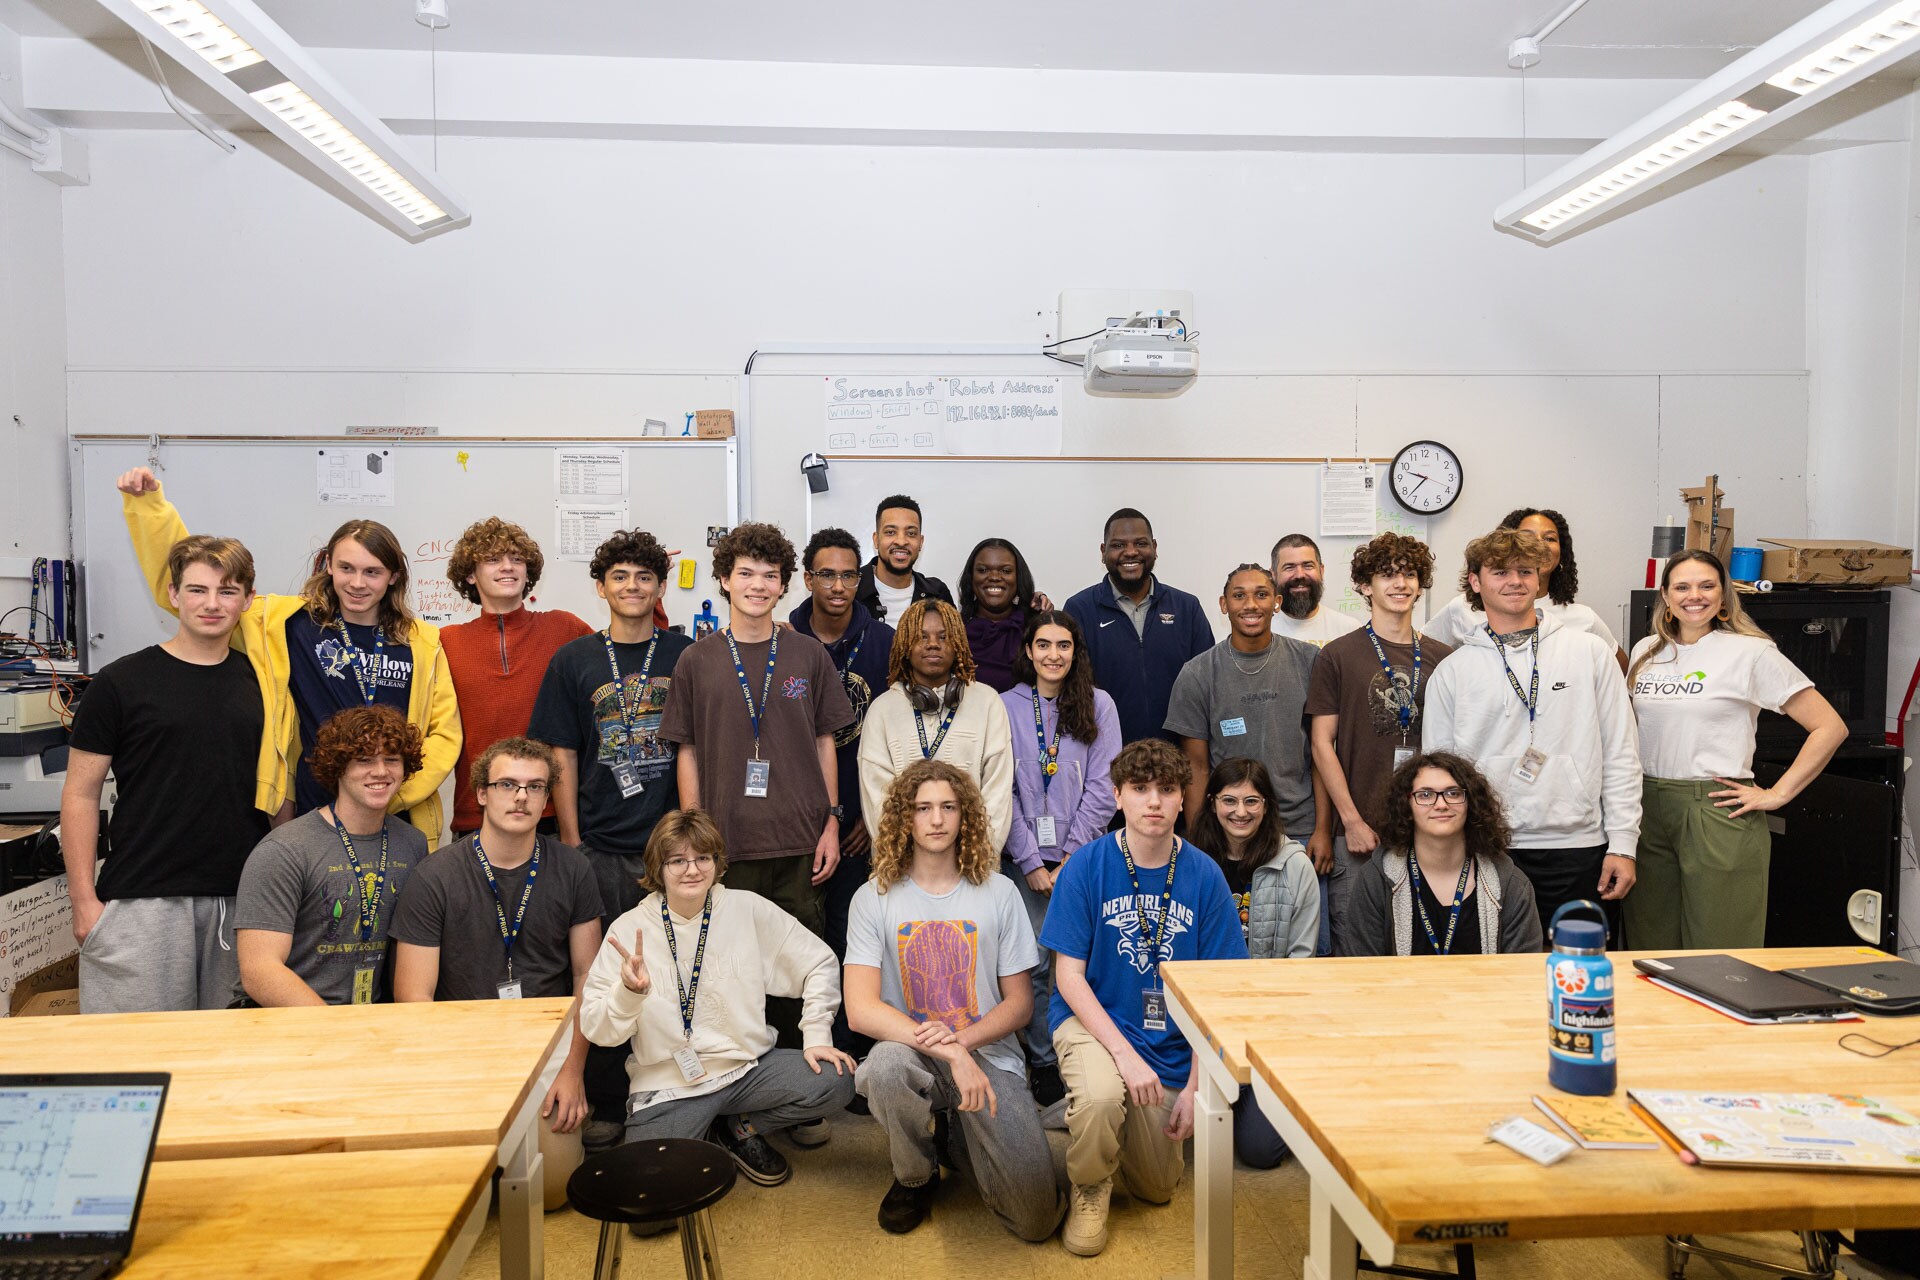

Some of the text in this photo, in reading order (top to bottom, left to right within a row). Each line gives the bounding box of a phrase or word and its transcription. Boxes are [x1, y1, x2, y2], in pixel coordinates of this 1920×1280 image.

[833, 378, 934, 400] Screenshot
[950, 378, 1054, 396] Robot Address
[1410, 453, 1416, 461] 11
[1421, 450, 1429, 458] 12
[1401, 463, 1410, 471] 10
[1444, 461, 1449, 469] 2
[1397, 474, 1403, 482] 9
[1448, 474, 1454, 482] 3
[1402, 487, 1408, 495] 8
[1436, 495, 1441, 503] 5
[1445, 486, 1450, 494] 4
[1412, 496, 1417, 504] 7
[1424, 498, 1429, 506] 6
[417, 540, 454, 556] CNC
[417, 591, 453, 600] Justice
[338, 618, 352, 647] LION PRIDE
[643, 659, 651, 672] LION
[647, 641, 656, 659] PRIDE
[727, 634, 740, 666] LION PRIDE
[1369, 632, 1386, 662] LION PRIDE
[354, 665, 362, 680] LION
[608, 648, 620, 680] LION PRIDE
[377, 680, 405, 688] RLEANS
[764, 672, 772, 691] PRIDE
[1508, 671, 1519, 689] PRIDE
[1639, 674, 1683, 682] COLLEGE
[1635, 682, 1703, 694] BEYOND
[631, 683, 644, 717] LION PRIDE
[742, 684, 755, 717] LION PRIDE
[916, 716, 926, 748] LION PRIDE
[935, 728, 946, 747] PRIDE
[348, 845, 357, 863] LION
[475, 845, 495, 882] LION PRIDE
[1121, 837, 1135, 875] LION PRIDE
[1166, 846, 1178, 885] LION PRIDE
[358, 877, 366, 899] PRIDE
[1457, 873, 1466, 893] PRIDE
[372, 887, 382, 906] LION
[516, 883, 532, 923] LION PRIDE
[1102, 894, 1194, 926] NEW ORLANS
[499, 916, 508, 938] PRIDE
[665, 920, 675, 941] PRIDE
[1140, 917, 1148, 933] LION
[1156, 907, 1167, 946] LION PRIDE
[1425, 919, 1434, 936] LION
[1444, 913, 1457, 950] LION PRIDE
[695, 928, 707, 967] LION PRIDE
[48, 999, 66, 1007] 150
[686, 981, 697, 1020] LION PRIDE
[1441, 1225, 1505, 1238] HUSKY
